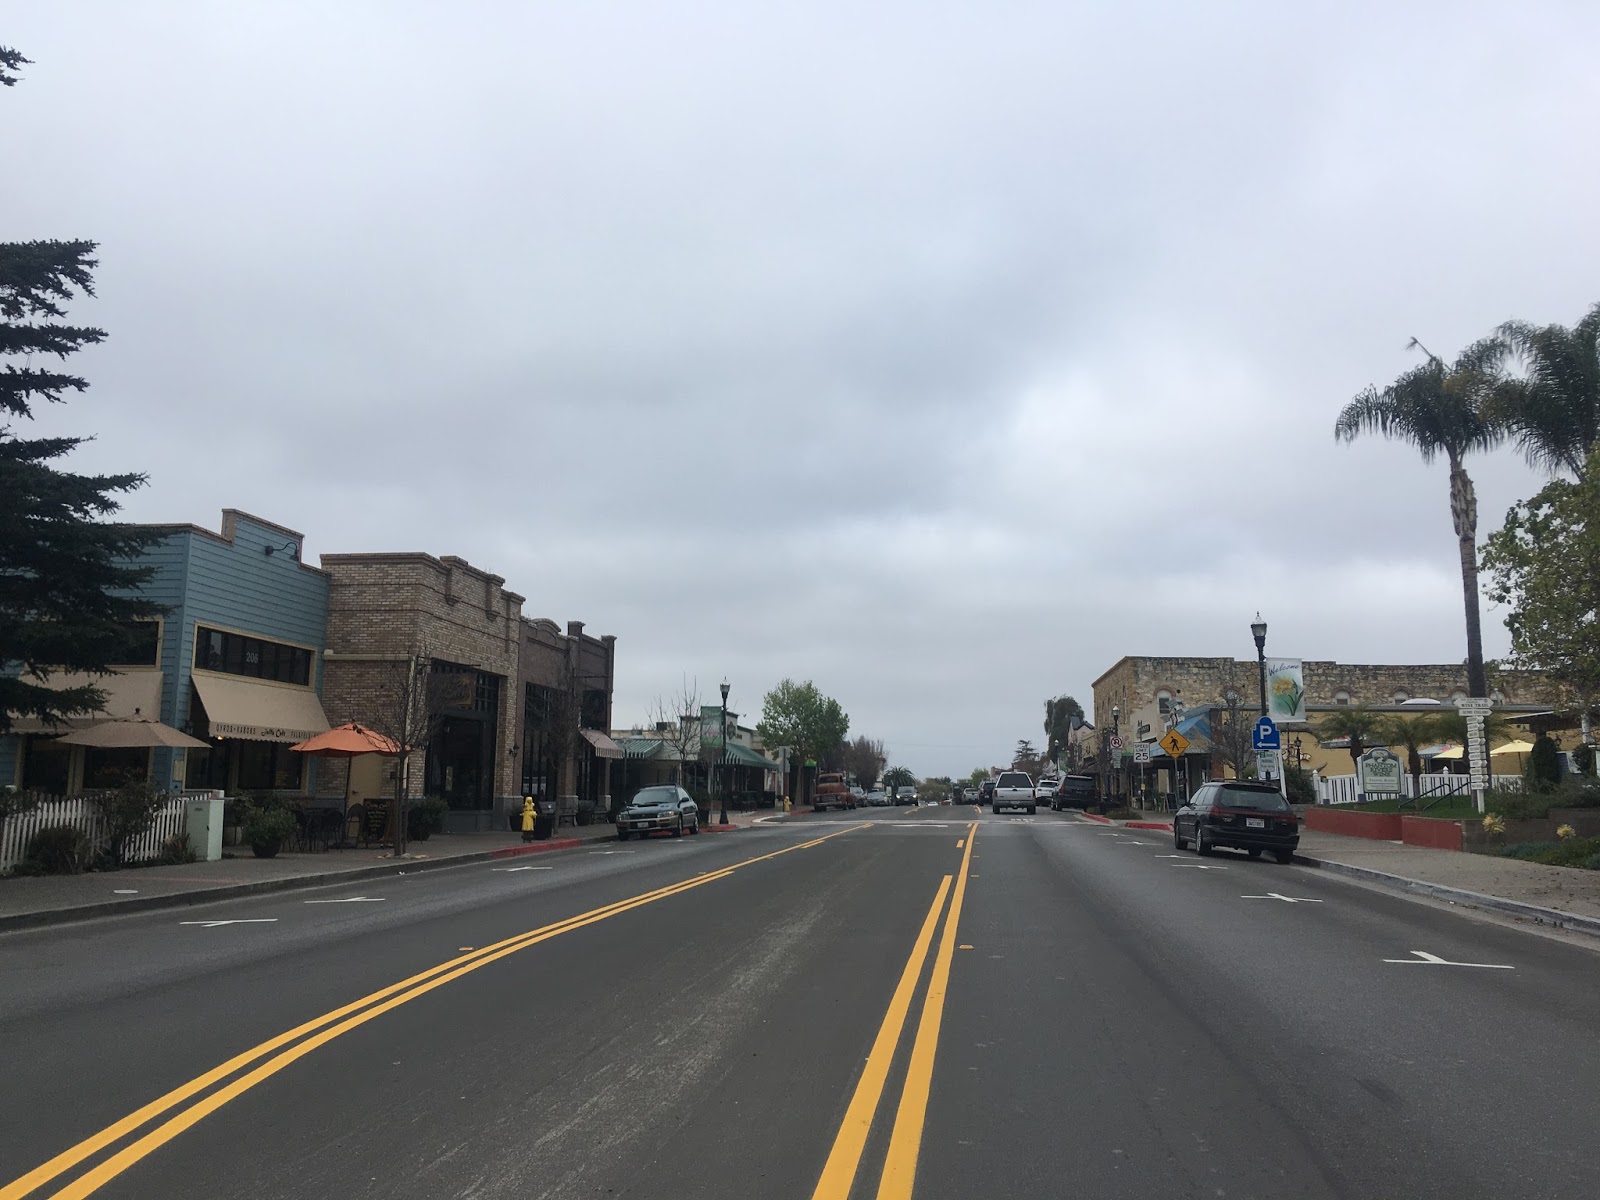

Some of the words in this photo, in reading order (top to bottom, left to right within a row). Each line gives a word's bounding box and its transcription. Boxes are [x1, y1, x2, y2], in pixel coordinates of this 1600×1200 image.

[1268, 662, 1299, 676] Welcome
[1260, 725, 1272, 740] P
[1135, 752, 1149, 761] 25
